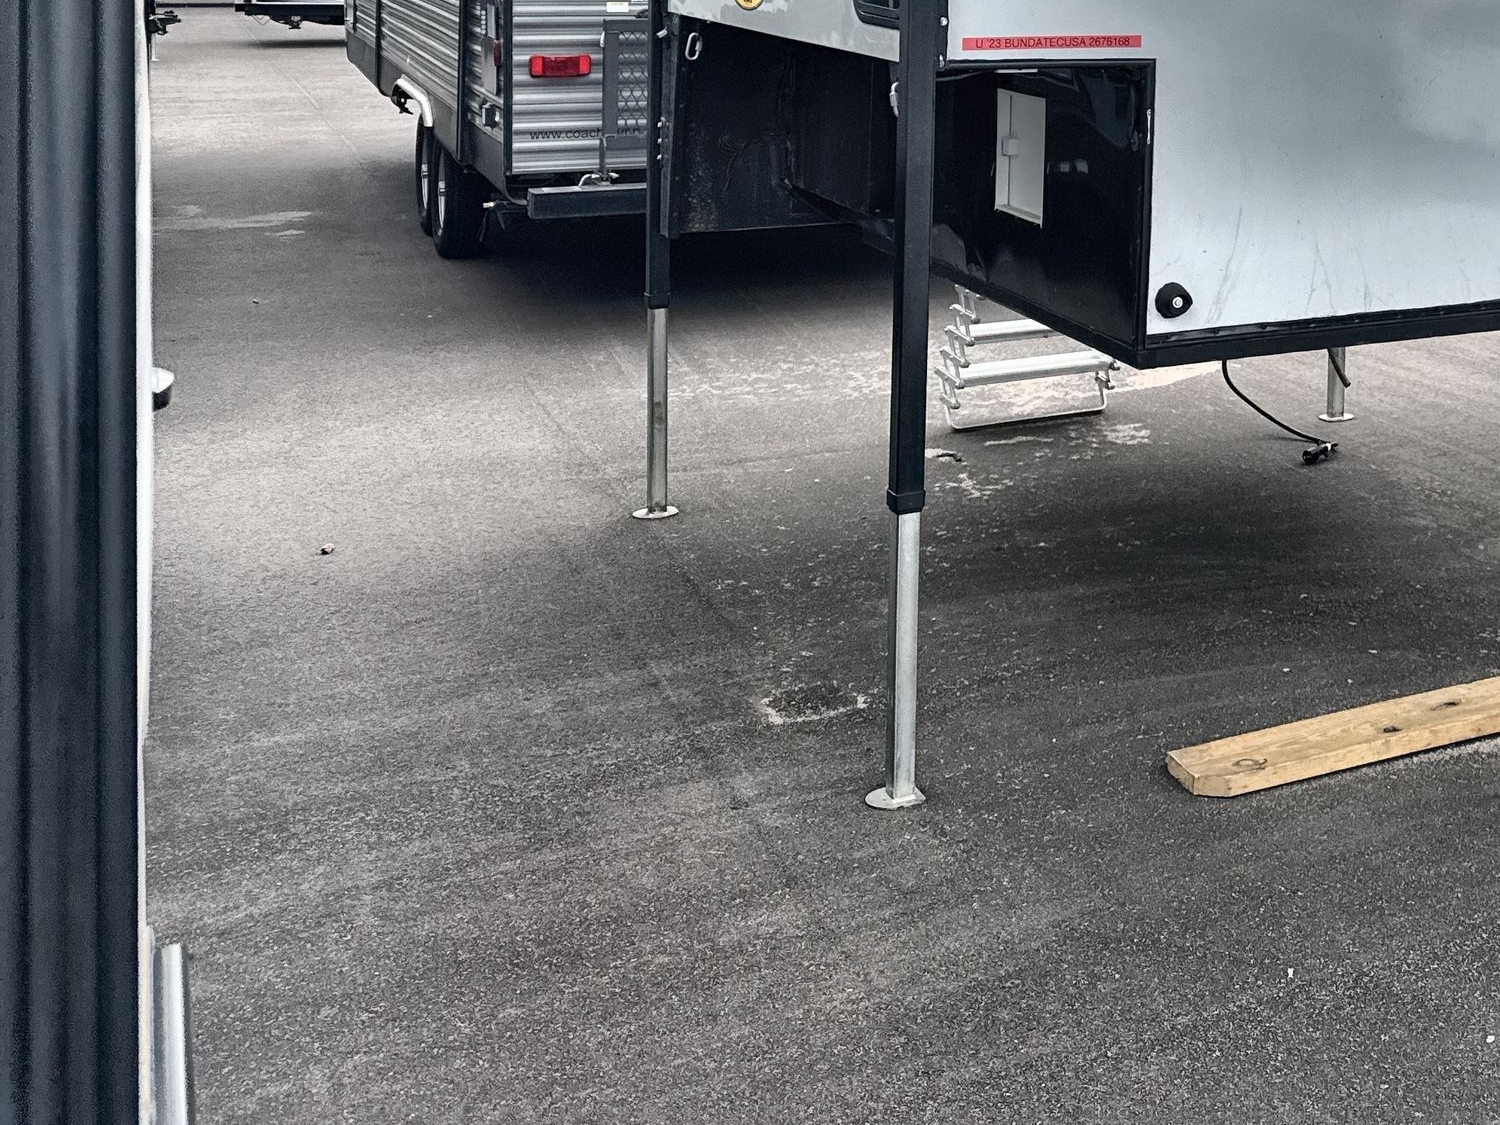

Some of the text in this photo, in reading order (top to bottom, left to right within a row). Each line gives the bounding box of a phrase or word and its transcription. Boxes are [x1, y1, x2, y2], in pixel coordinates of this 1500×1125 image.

[975, 38, 983, 49] U
[1004, 35, 1087, 48] BUNDATECUSA
[1088, 34, 1130, 47] 2676168
